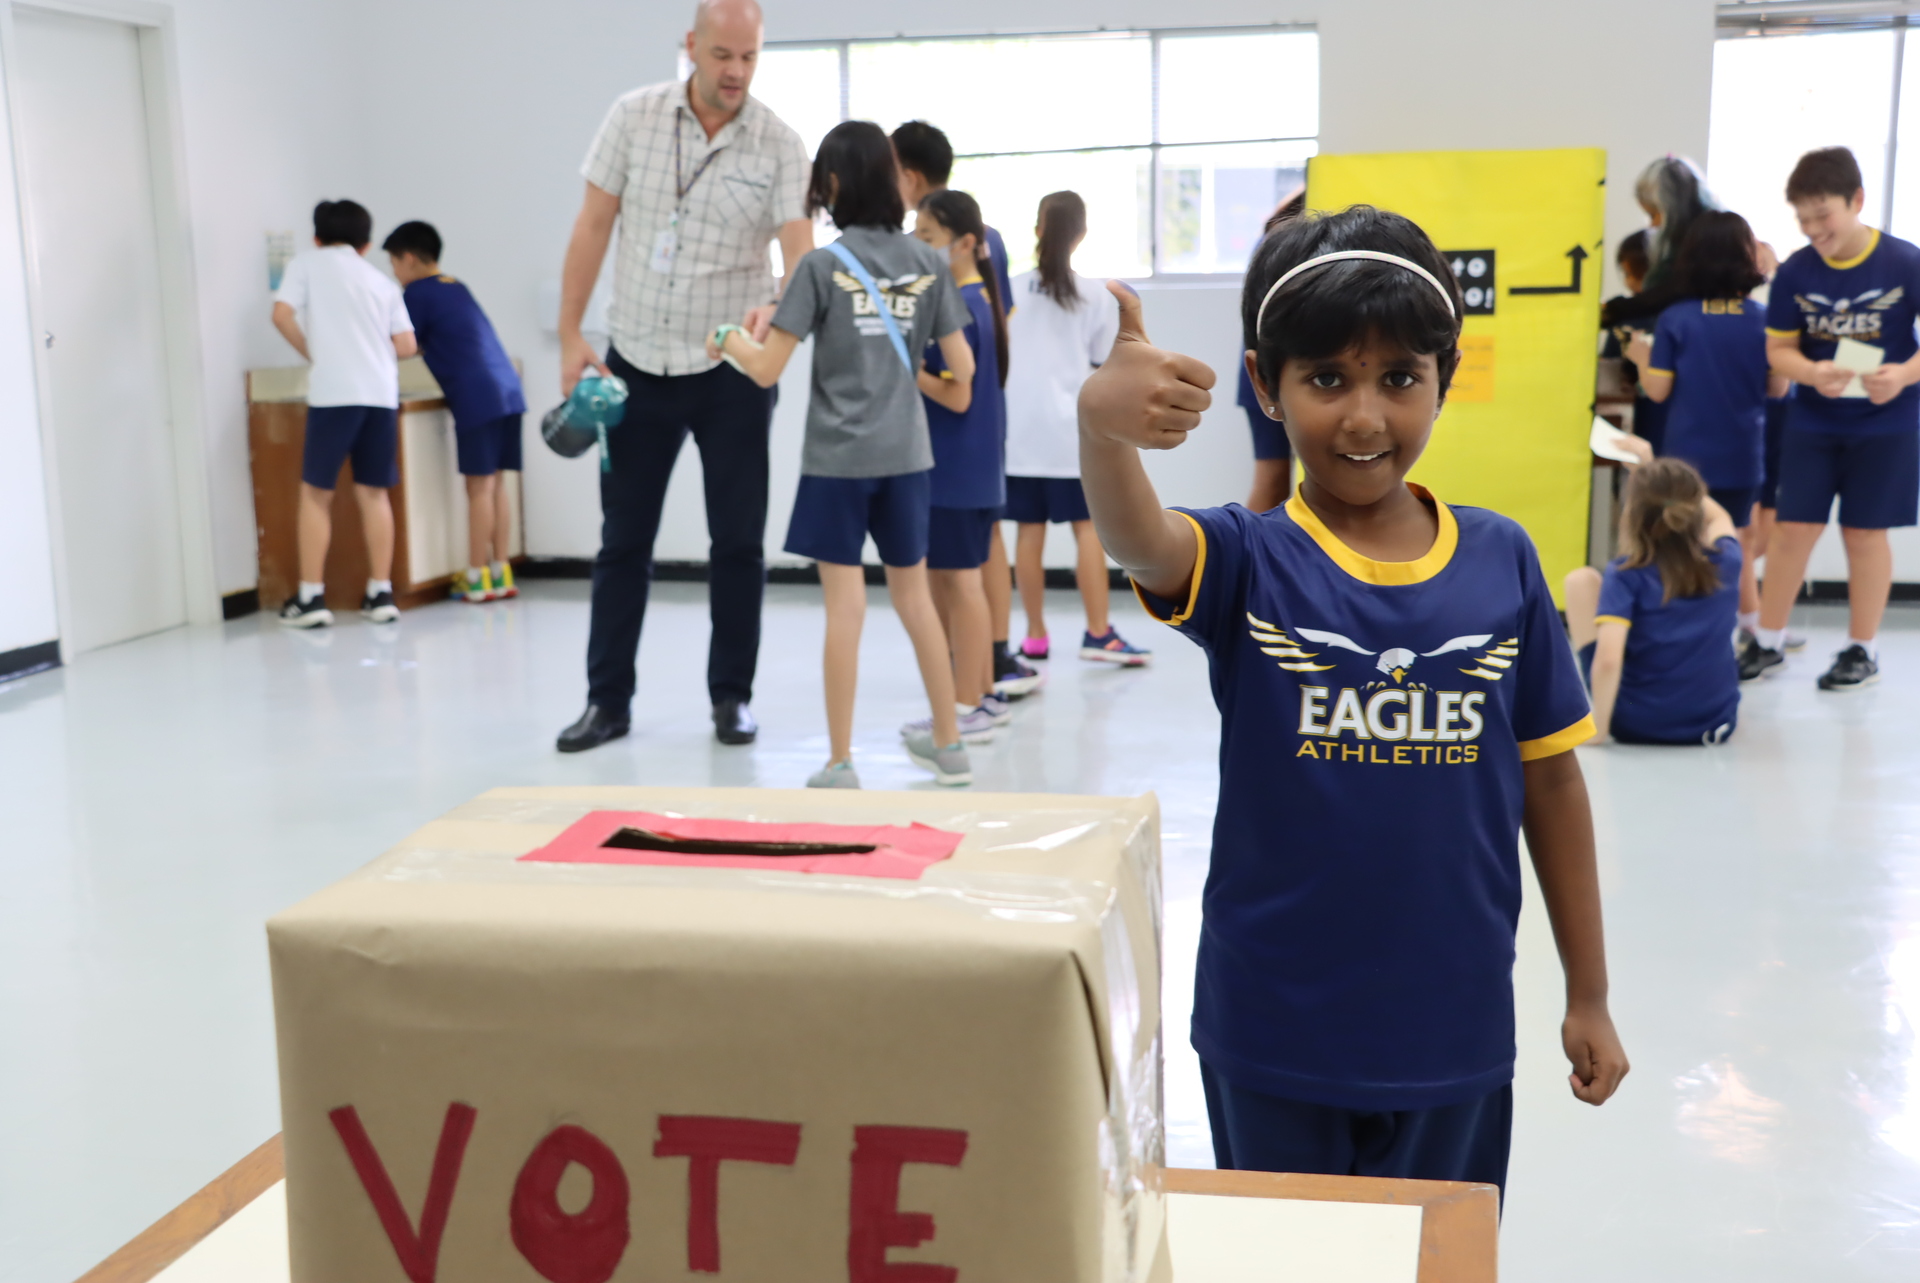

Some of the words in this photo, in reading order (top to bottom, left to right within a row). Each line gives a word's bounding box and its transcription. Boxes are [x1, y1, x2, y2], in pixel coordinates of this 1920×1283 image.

[852, 292, 917, 318] EALES
[1298, 684, 1486, 741] EAGLES
[1296, 740, 1479, 764] ATHLETICS
[328, 1101, 968, 1283] VOTE
